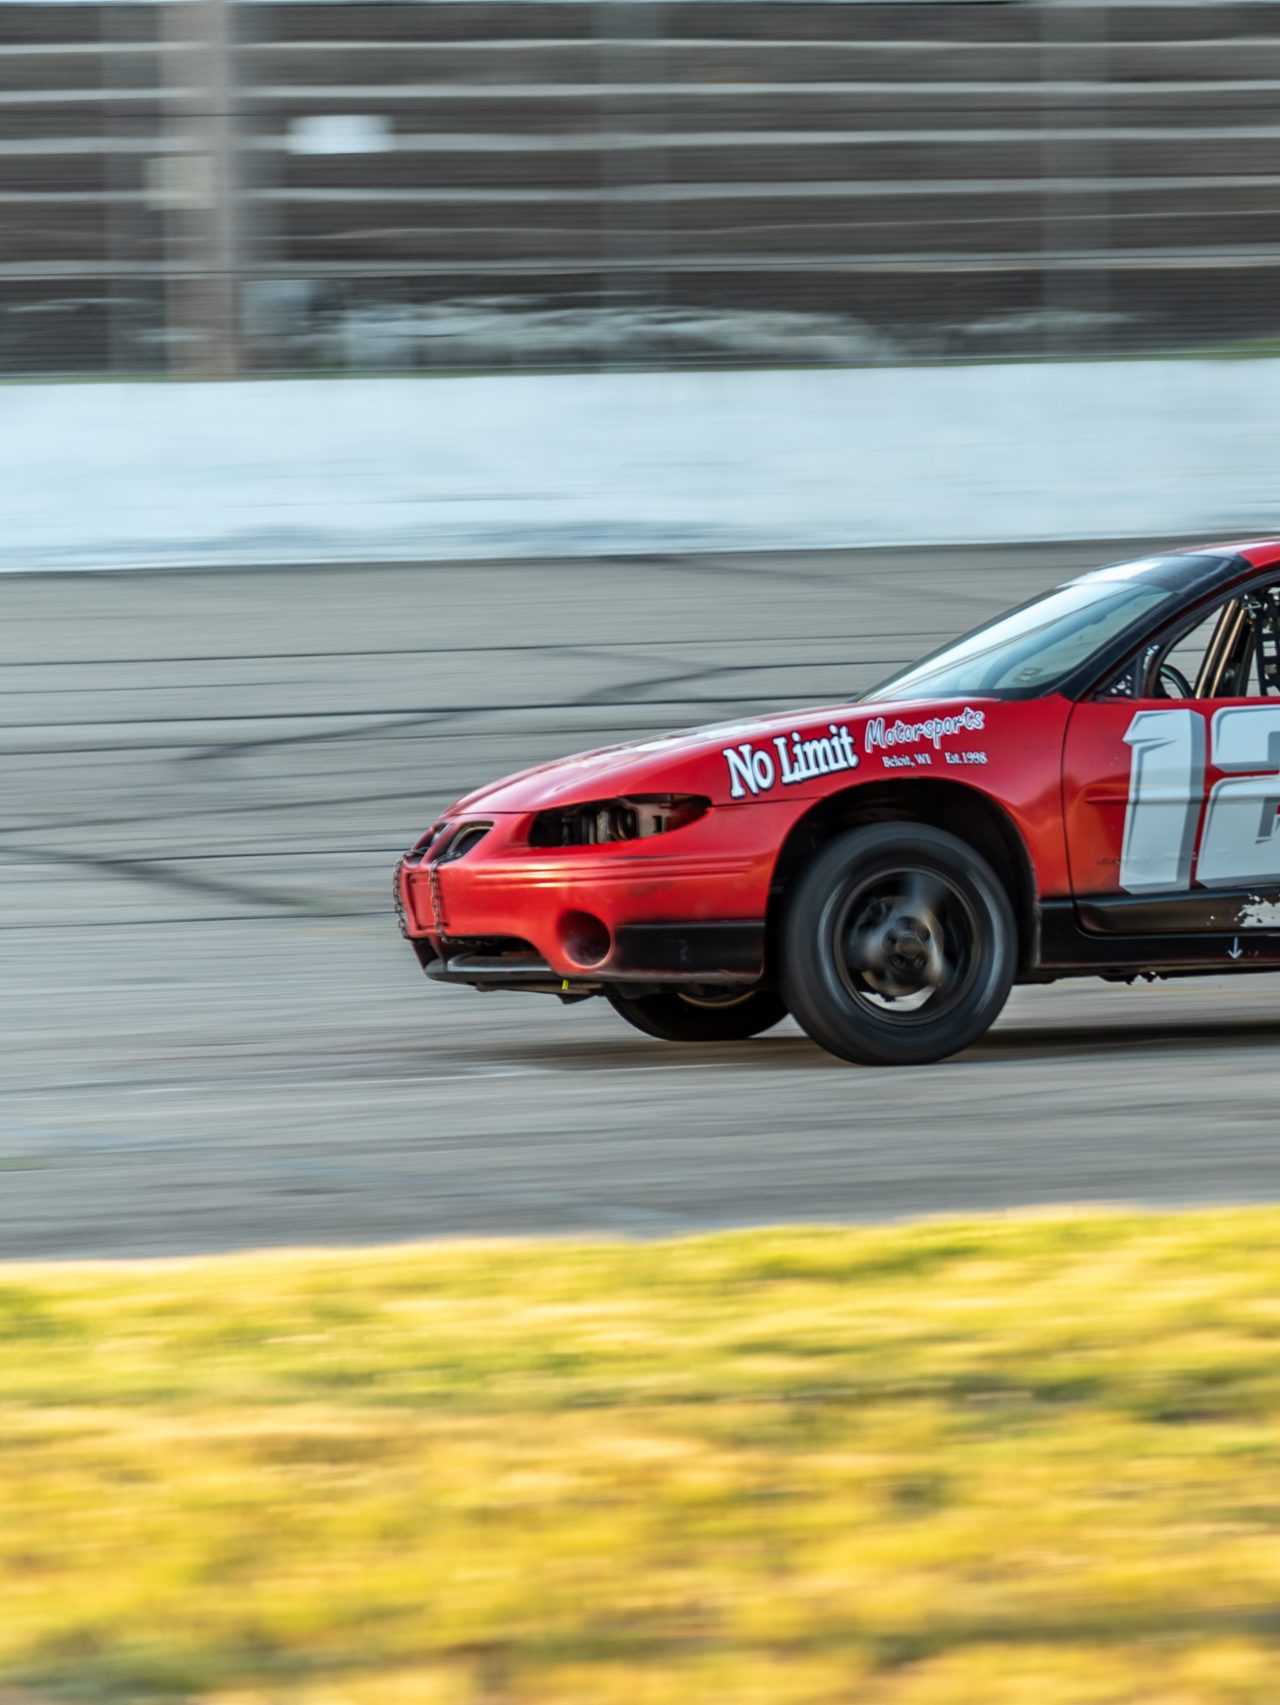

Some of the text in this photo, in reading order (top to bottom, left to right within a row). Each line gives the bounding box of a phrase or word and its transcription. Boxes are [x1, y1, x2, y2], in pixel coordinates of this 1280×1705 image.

[865, 707, 984, 753] Motorsports
[722, 723, 859, 799] No Limit
[914, 752, 932, 764] WI
